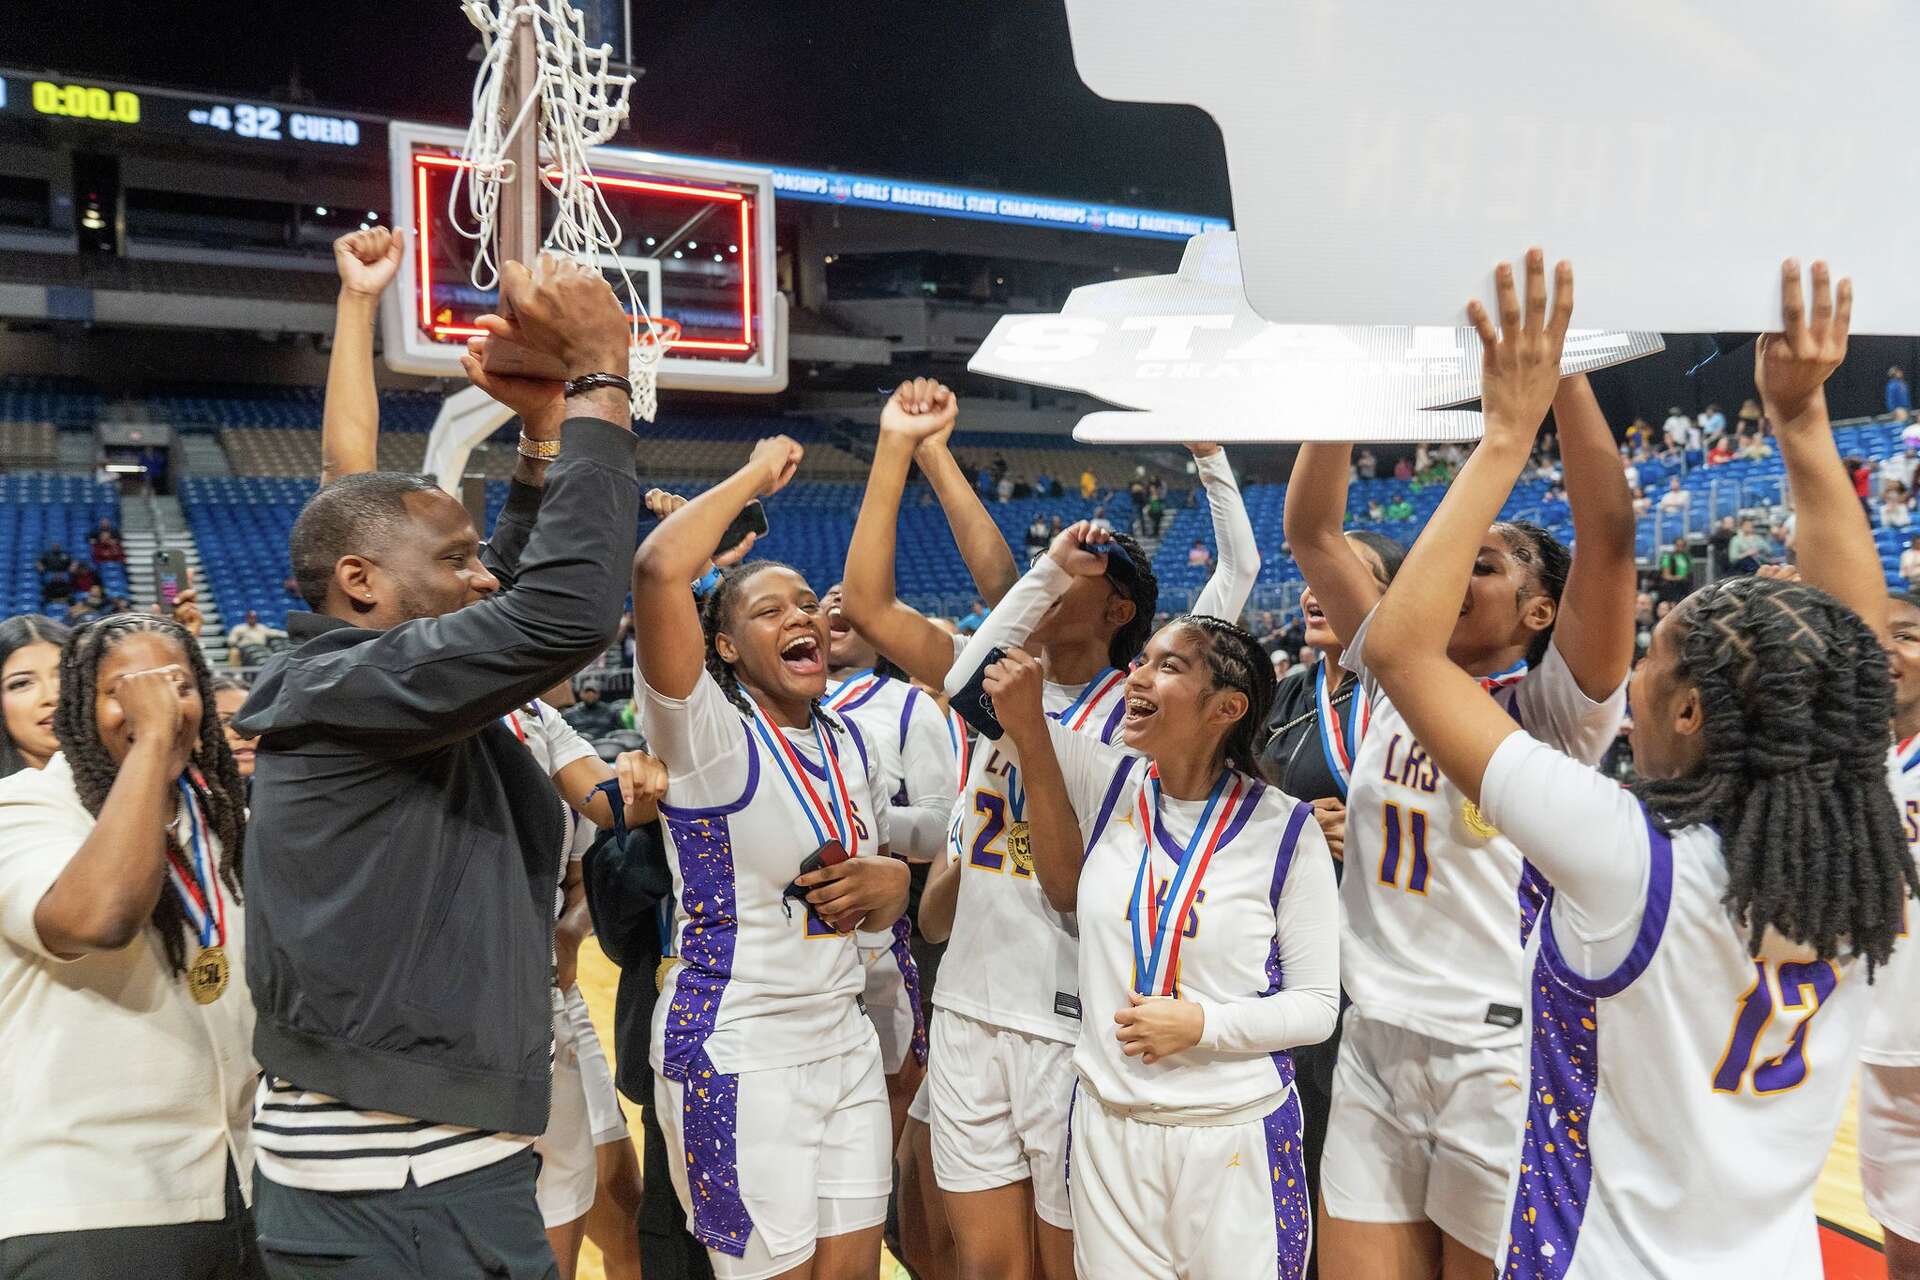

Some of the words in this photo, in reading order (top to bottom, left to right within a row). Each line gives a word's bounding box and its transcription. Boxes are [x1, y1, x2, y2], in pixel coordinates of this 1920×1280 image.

[32, 81, 140, 124] 0:00.0
[234, 104, 282, 140] 32
[289, 112, 360, 146] CUERO
[852, 182, 890, 202] GIRLS
[891, 187, 964, 211] BASKETBALL
[998, 200, 1086, 224] CHAMPIONSHIPS
[1135, 361, 1462, 380] CHAMONS
[968, 787, 1034, 880] 2
[1377, 800, 1431, 896] 11
